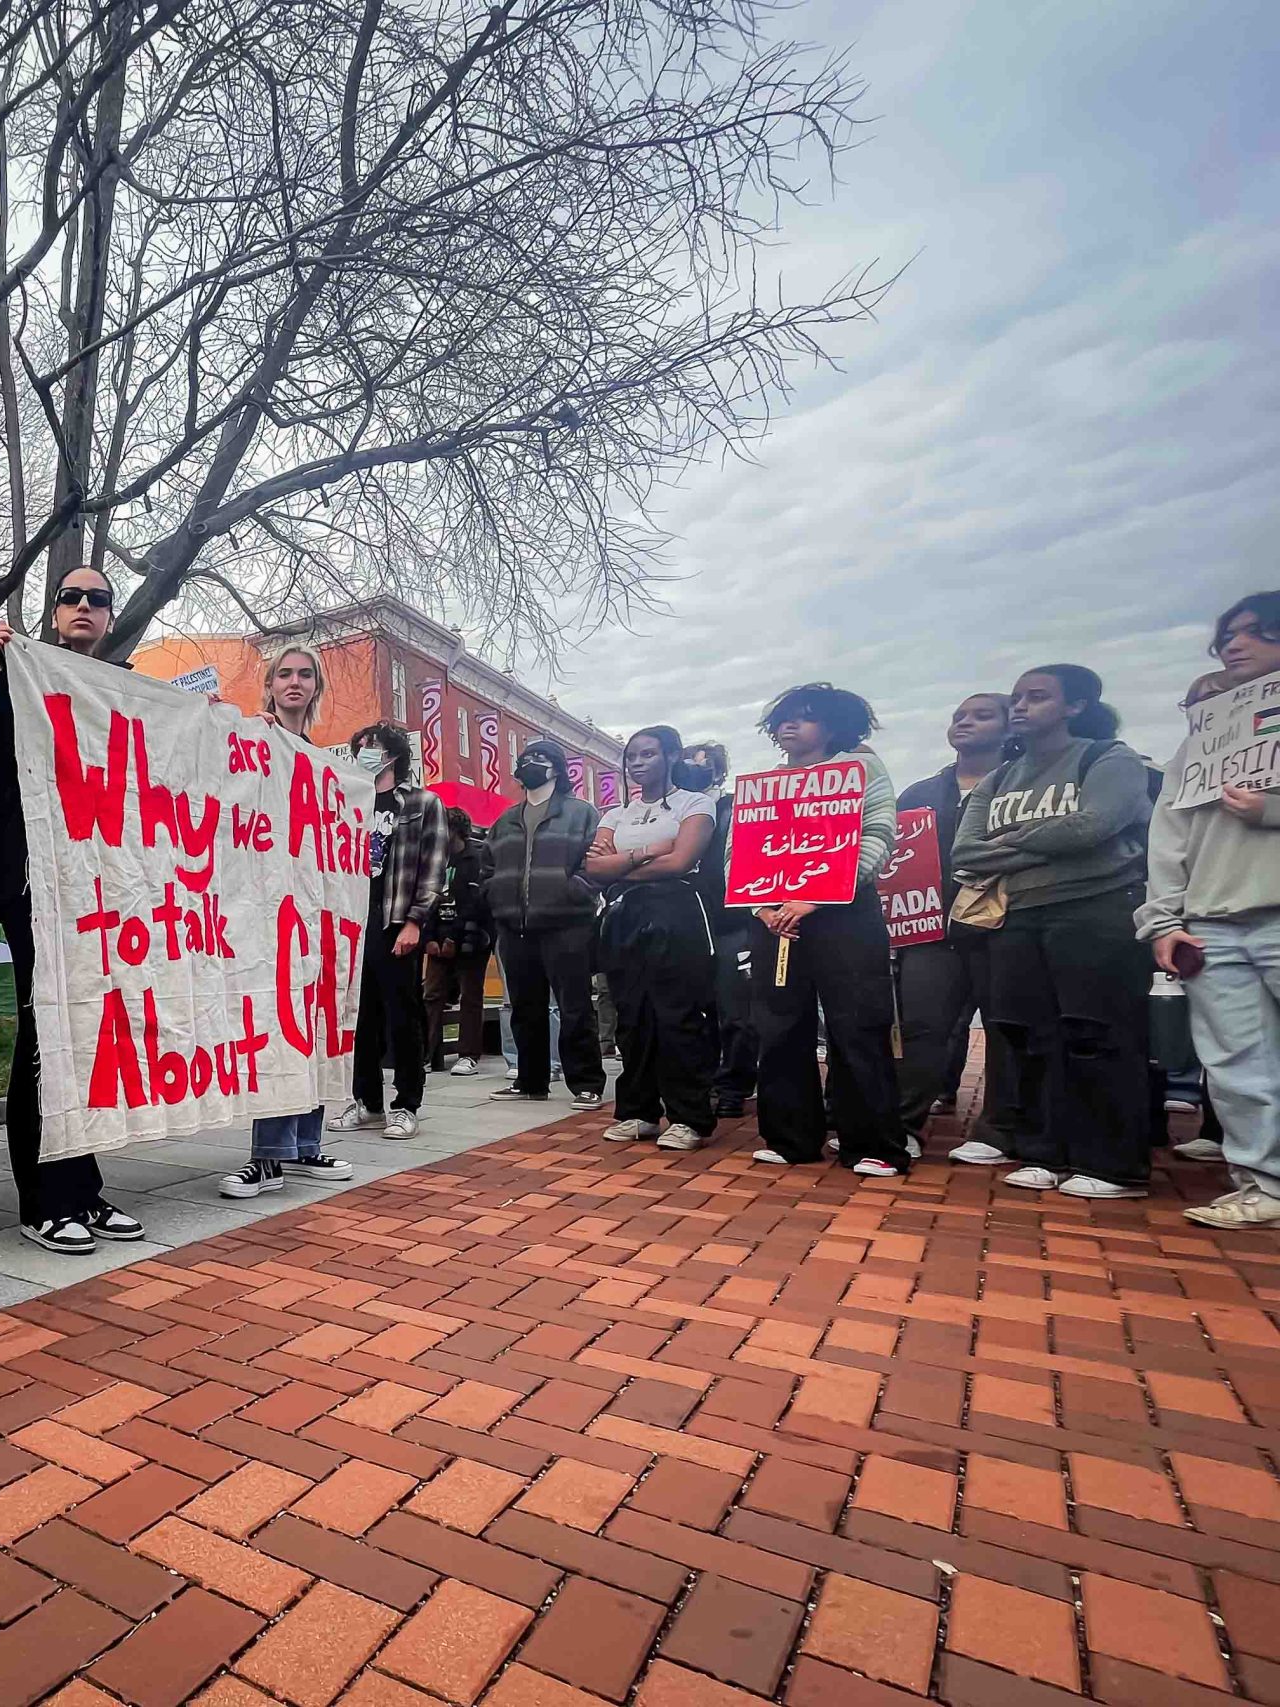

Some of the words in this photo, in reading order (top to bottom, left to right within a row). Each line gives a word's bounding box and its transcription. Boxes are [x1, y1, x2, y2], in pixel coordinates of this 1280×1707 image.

[1261, 680, 1280, 700] FR
[227, 731, 272, 777] are
[43, 692, 221, 892] Why
[736, 767, 862, 805] INTIFADA
[737, 805, 779, 823] UNTIL
[793, 798, 864, 818] VICTORY
[987, 782, 1081, 835] RTLAN
[232, 803, 274, 852] we
[761, 828, 858, 857] الانتفاضة
[734, 870, 784, 896] النصر
[784, 860, 830, 891] حتى
[880, 886, 942, 919] FADA
[76, 876, 150, 976] to
[152, 881, 235, 961] talk
[886, 914, 943, 938] VICTORY
[87, 986, 269, 1110] About
[276, 895, 362, 1059] GAZ
